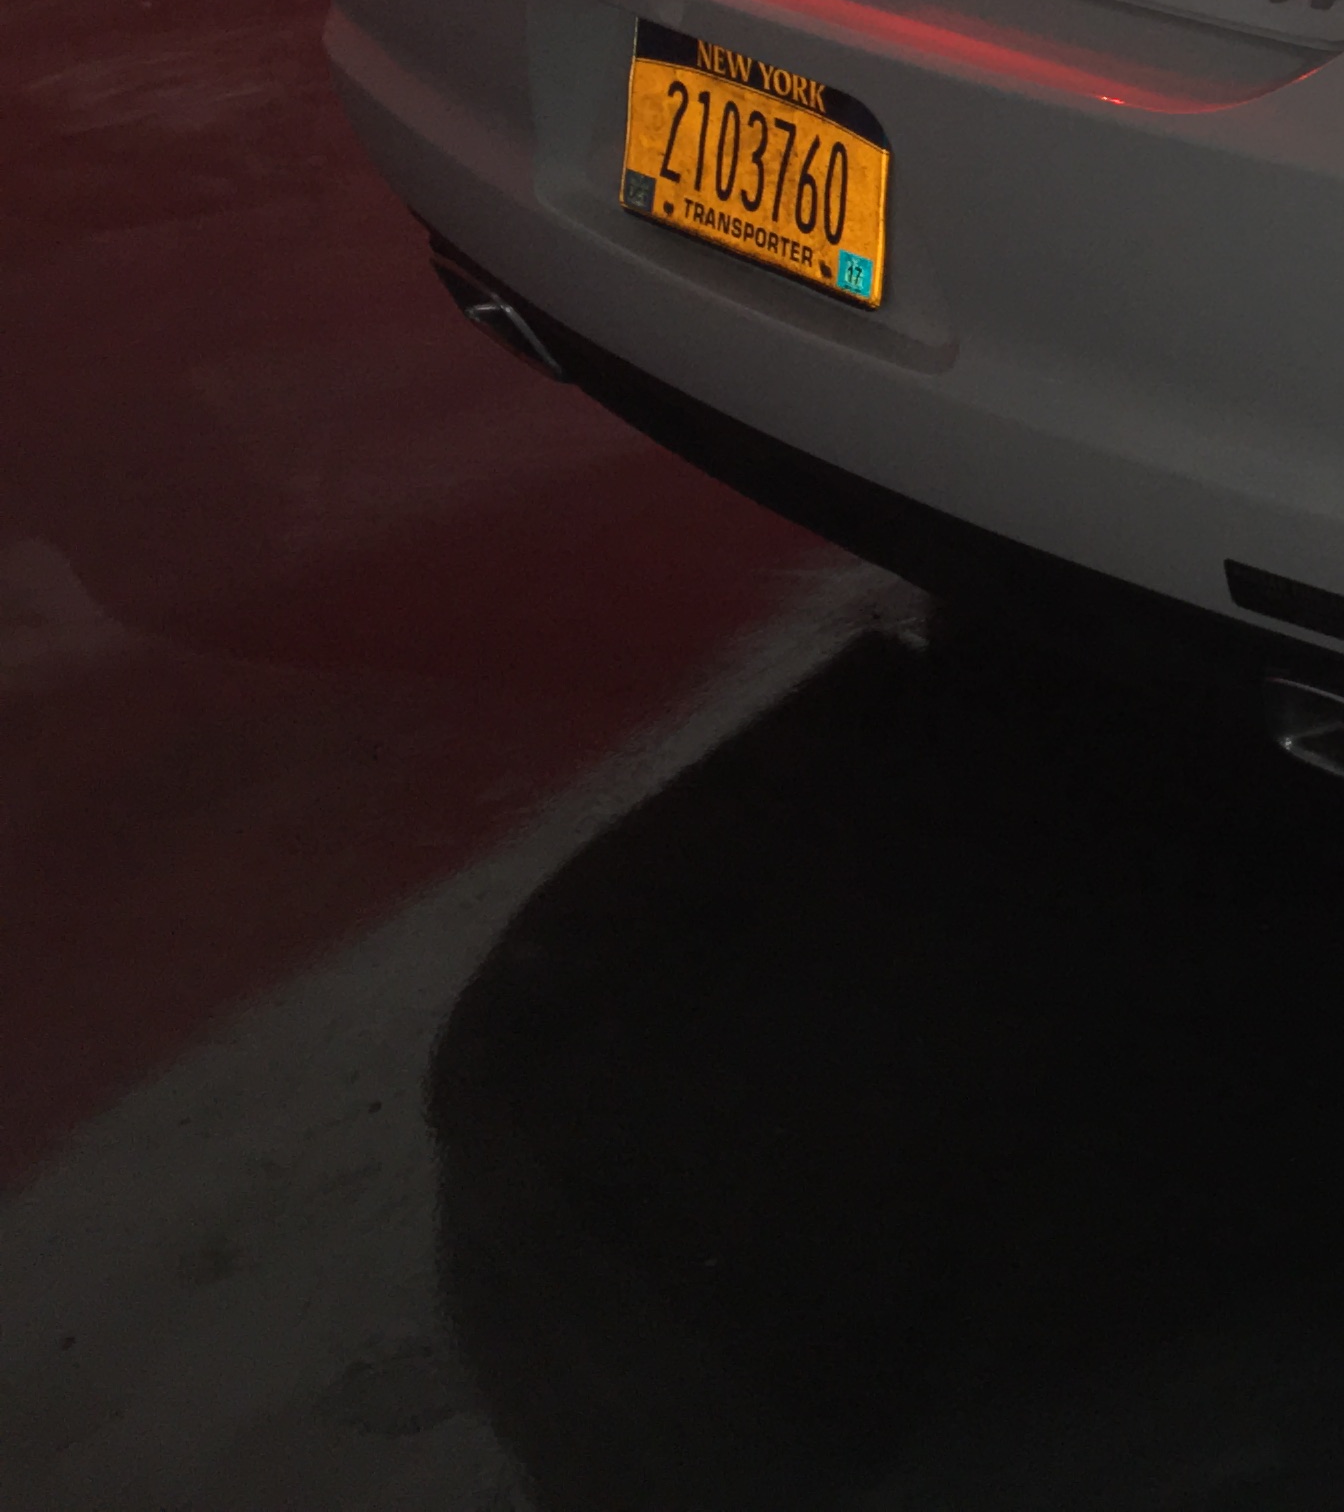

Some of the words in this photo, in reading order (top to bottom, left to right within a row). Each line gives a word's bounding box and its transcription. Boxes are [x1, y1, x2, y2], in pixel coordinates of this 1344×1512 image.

[697, 39, 752, 83] NEW
[757, 60, 827, 114] YORK
[659, 80, 849, 245] 2103760
[684, 197, 814, 268] TRANSPORTER
